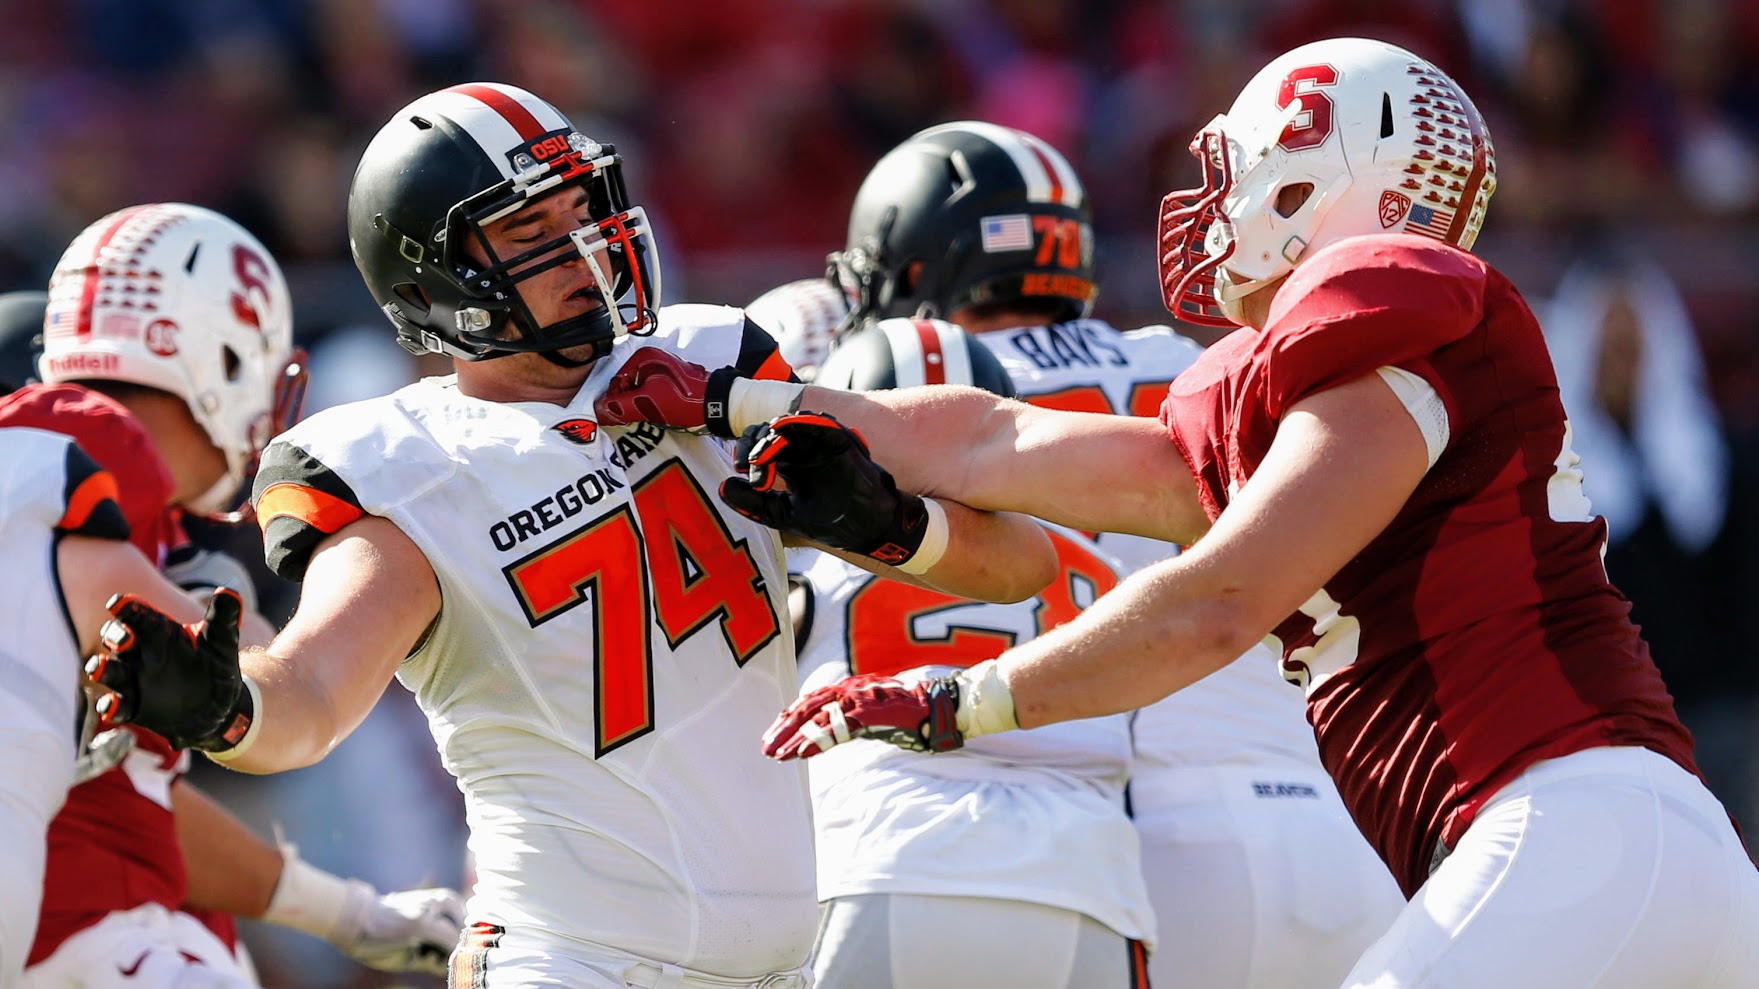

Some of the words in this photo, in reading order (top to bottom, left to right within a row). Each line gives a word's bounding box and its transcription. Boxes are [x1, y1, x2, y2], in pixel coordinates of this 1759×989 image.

[1275, 63, 1340, 153] S
[531, 134, 569, 160] OSU
[1381, 192, 1409, 218] PAC
[1382, 207, 1398, 223] 12
[1032, 214, 1080, 269] 70
[230, 243, 271, 330] S
[1011, 319, 1129, 369] BAYS
[489, 467, 625, 552] OREGON
[502, 456, 781, 760] 74
